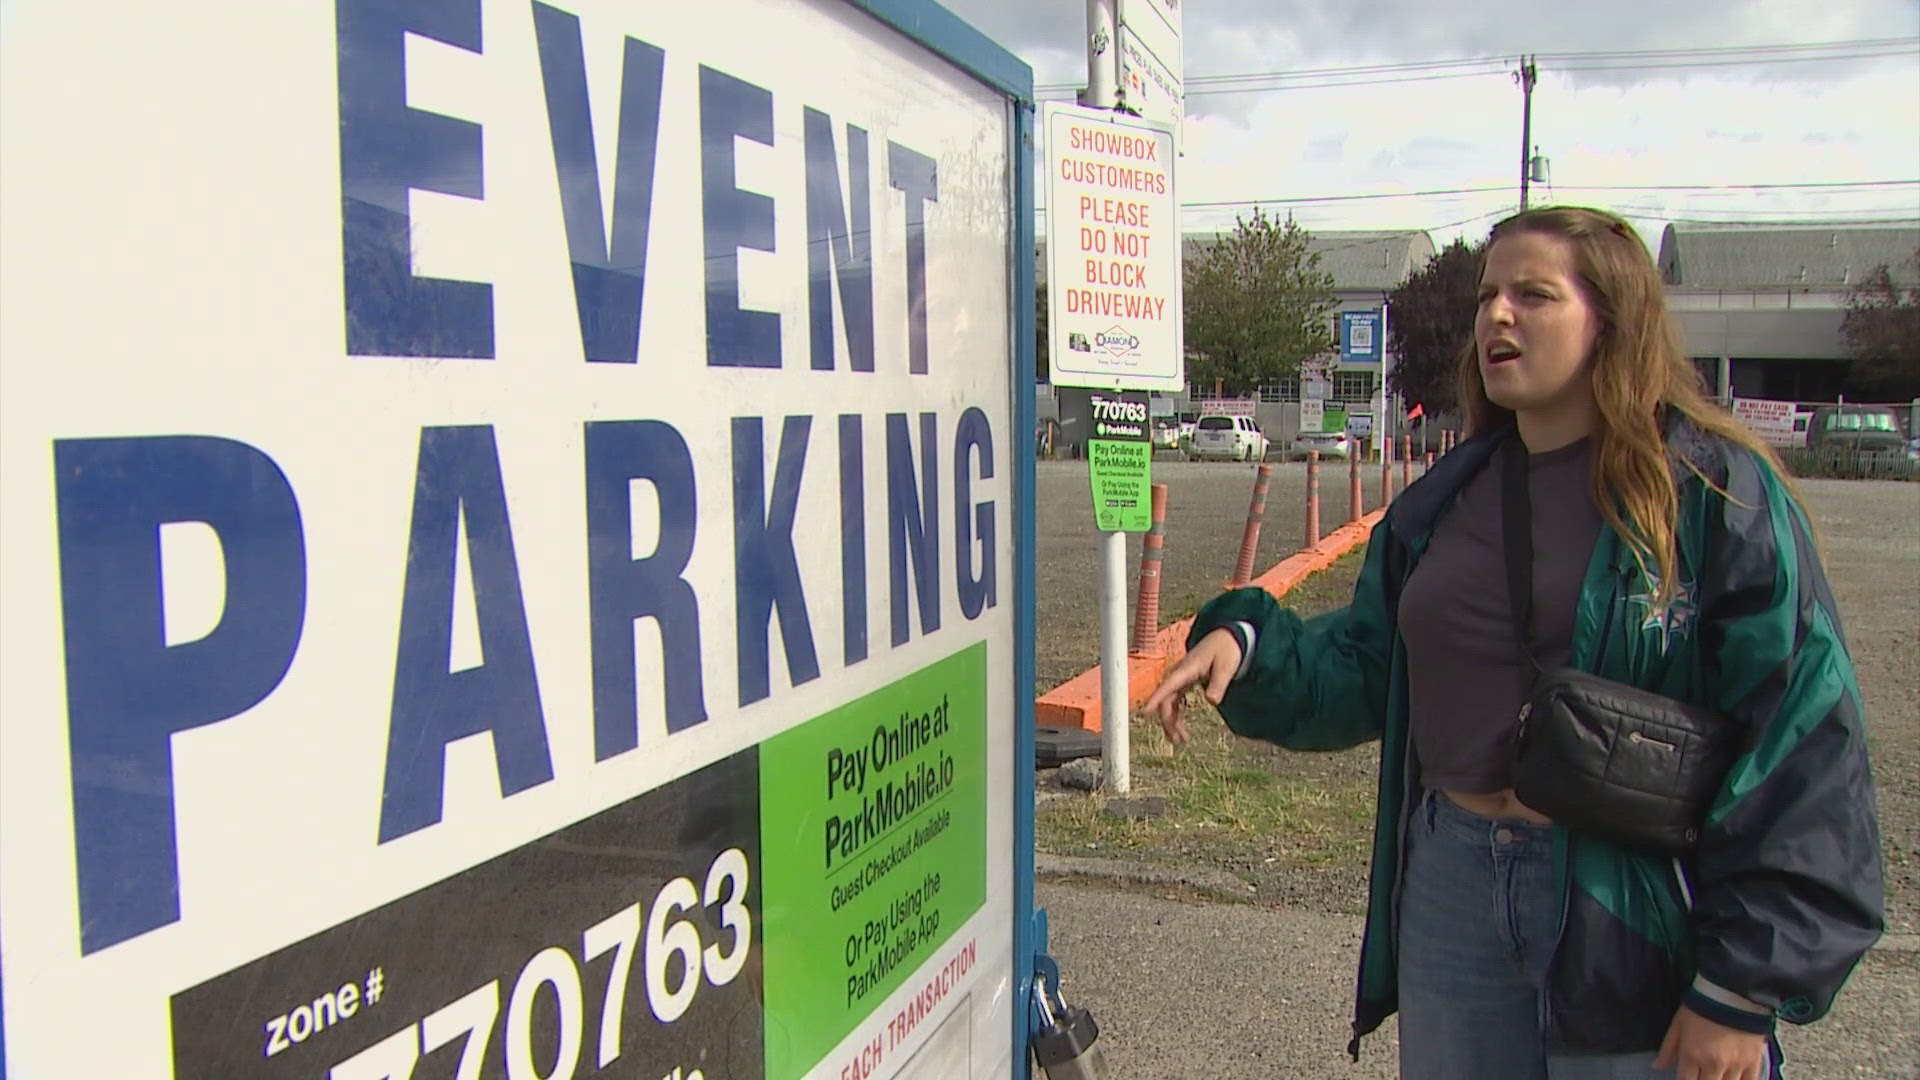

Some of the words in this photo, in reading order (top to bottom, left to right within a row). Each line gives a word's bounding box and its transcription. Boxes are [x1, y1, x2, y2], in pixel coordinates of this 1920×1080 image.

[1061, 158, 1166, 195] CUSTOMERS
[1070, 126, 1157, 162] SHOWBOX
[335, 0, 938, 375] EVENT
[1080, 195, 1150, 228] PLEASE
[1080, 227, 1106, 254] DO
[1114, 231, 1151, 258] NOT
[1086, 259, 1146, 289] BLOCK
[1066, 288, 1165, 321] DRIVEWAY
[1091, 400, 1147, 421] 770763
[1094, 443, 1109, 457] Pay
[1110, 444, 1135, 456] Online
[1136, 446, 1144, 456] at
[1094, 456, 1146, 469] ParkMobile.io
[52, 406, 999, 958] PARKING
[827, 744, 869, 800] Pay
[872, 711, 931, 773] Online
[932, 693, 949, 739] at
[825, 749, 954, 869] ParkMobile.io
[831, 868, 864, 912] Guest
[865, 834, 912, 887] Checkout
[913, 809, 950, 853] Available
[845, 933, 863, 968] Or
[864, 914, 890, 954] Pay
[890, 886, 923, 931] Using
[923, 872, 941, 902] the
[847, 926, 917, 1010] ParkMobile
[917, 908, 940, 946] App
[262, 981, 361, 1059] zone
[365, 966, 384, 1007] #
[887, 937, 978, 1052] TRANSACTION
